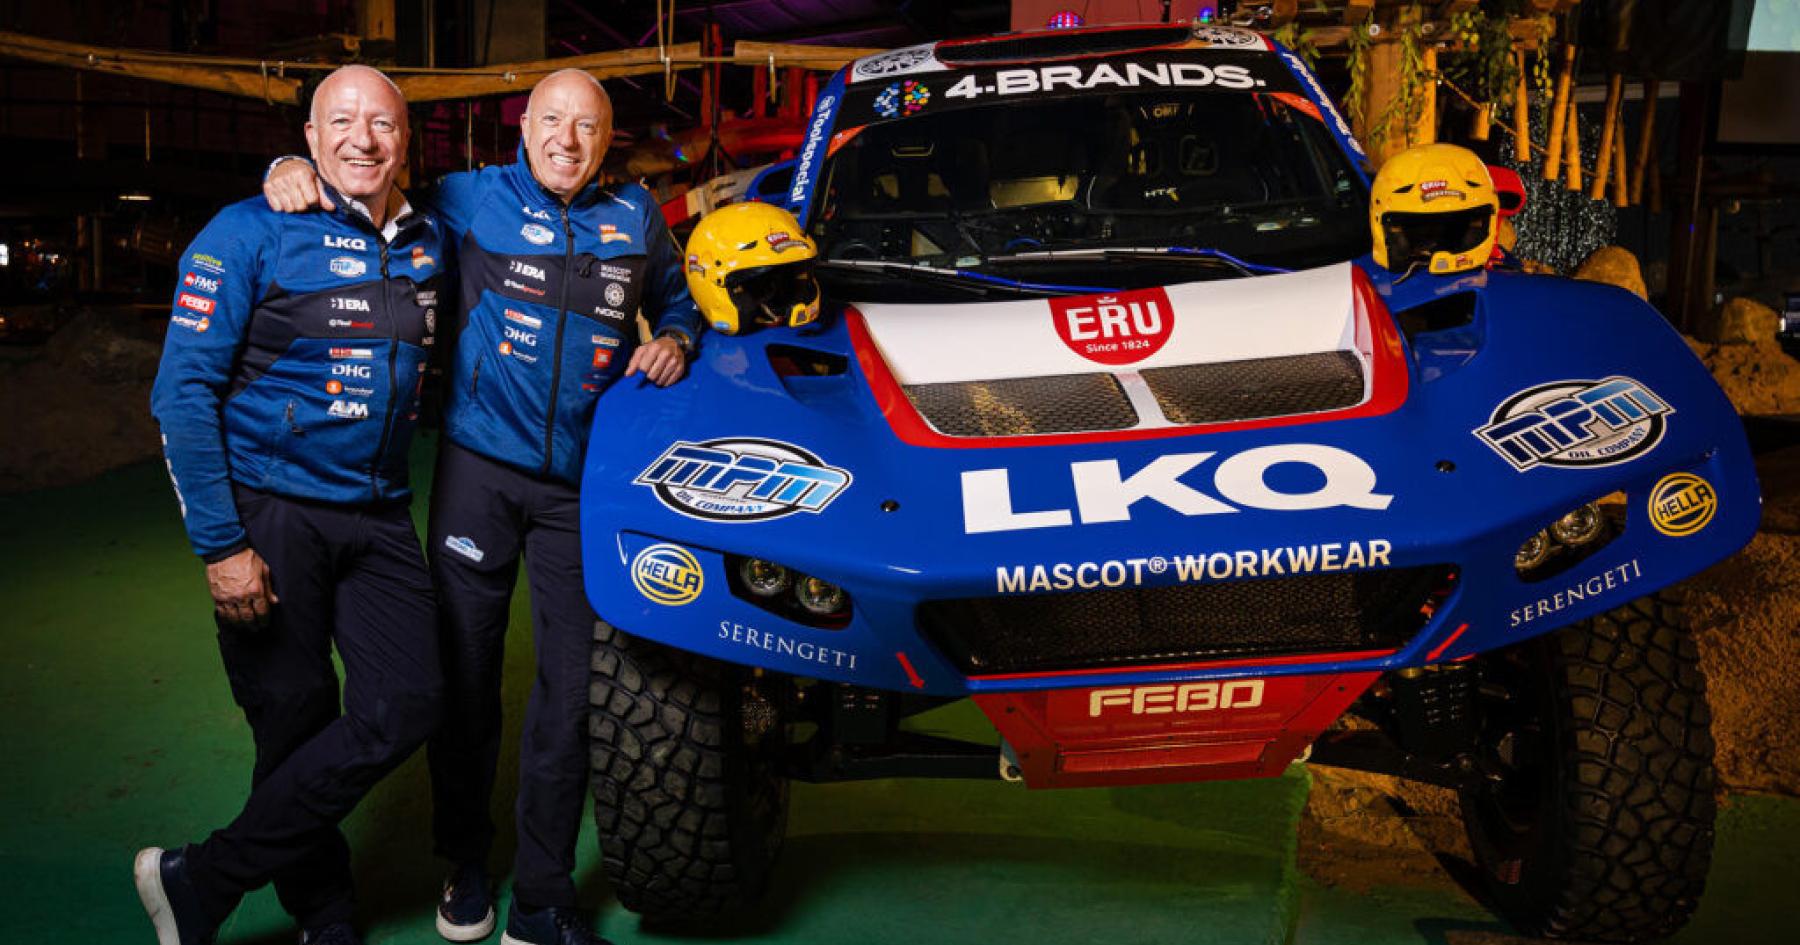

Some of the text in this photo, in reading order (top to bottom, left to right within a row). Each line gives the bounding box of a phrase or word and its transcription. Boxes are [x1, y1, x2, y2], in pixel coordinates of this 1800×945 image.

[324, 234, 368, 251] LKQ
[1066, 301, 1163, 341] ERU
[1086, 340, 1150, 354] Since 1824
[331, 364, 371, 379] DHG
[961, 443, 1395, 534] LKQ
[1657, 484, 1713, 521] HELLA
[640, 556, 701, 593] HELLA
[1174, 539, 1392, 583] WORKWEAR
[1510, 559, 1642, 628] SERENGETI
[718, 620, 857, 669] SERENGETI
[1089, 679, 1265, 717] FEBO
